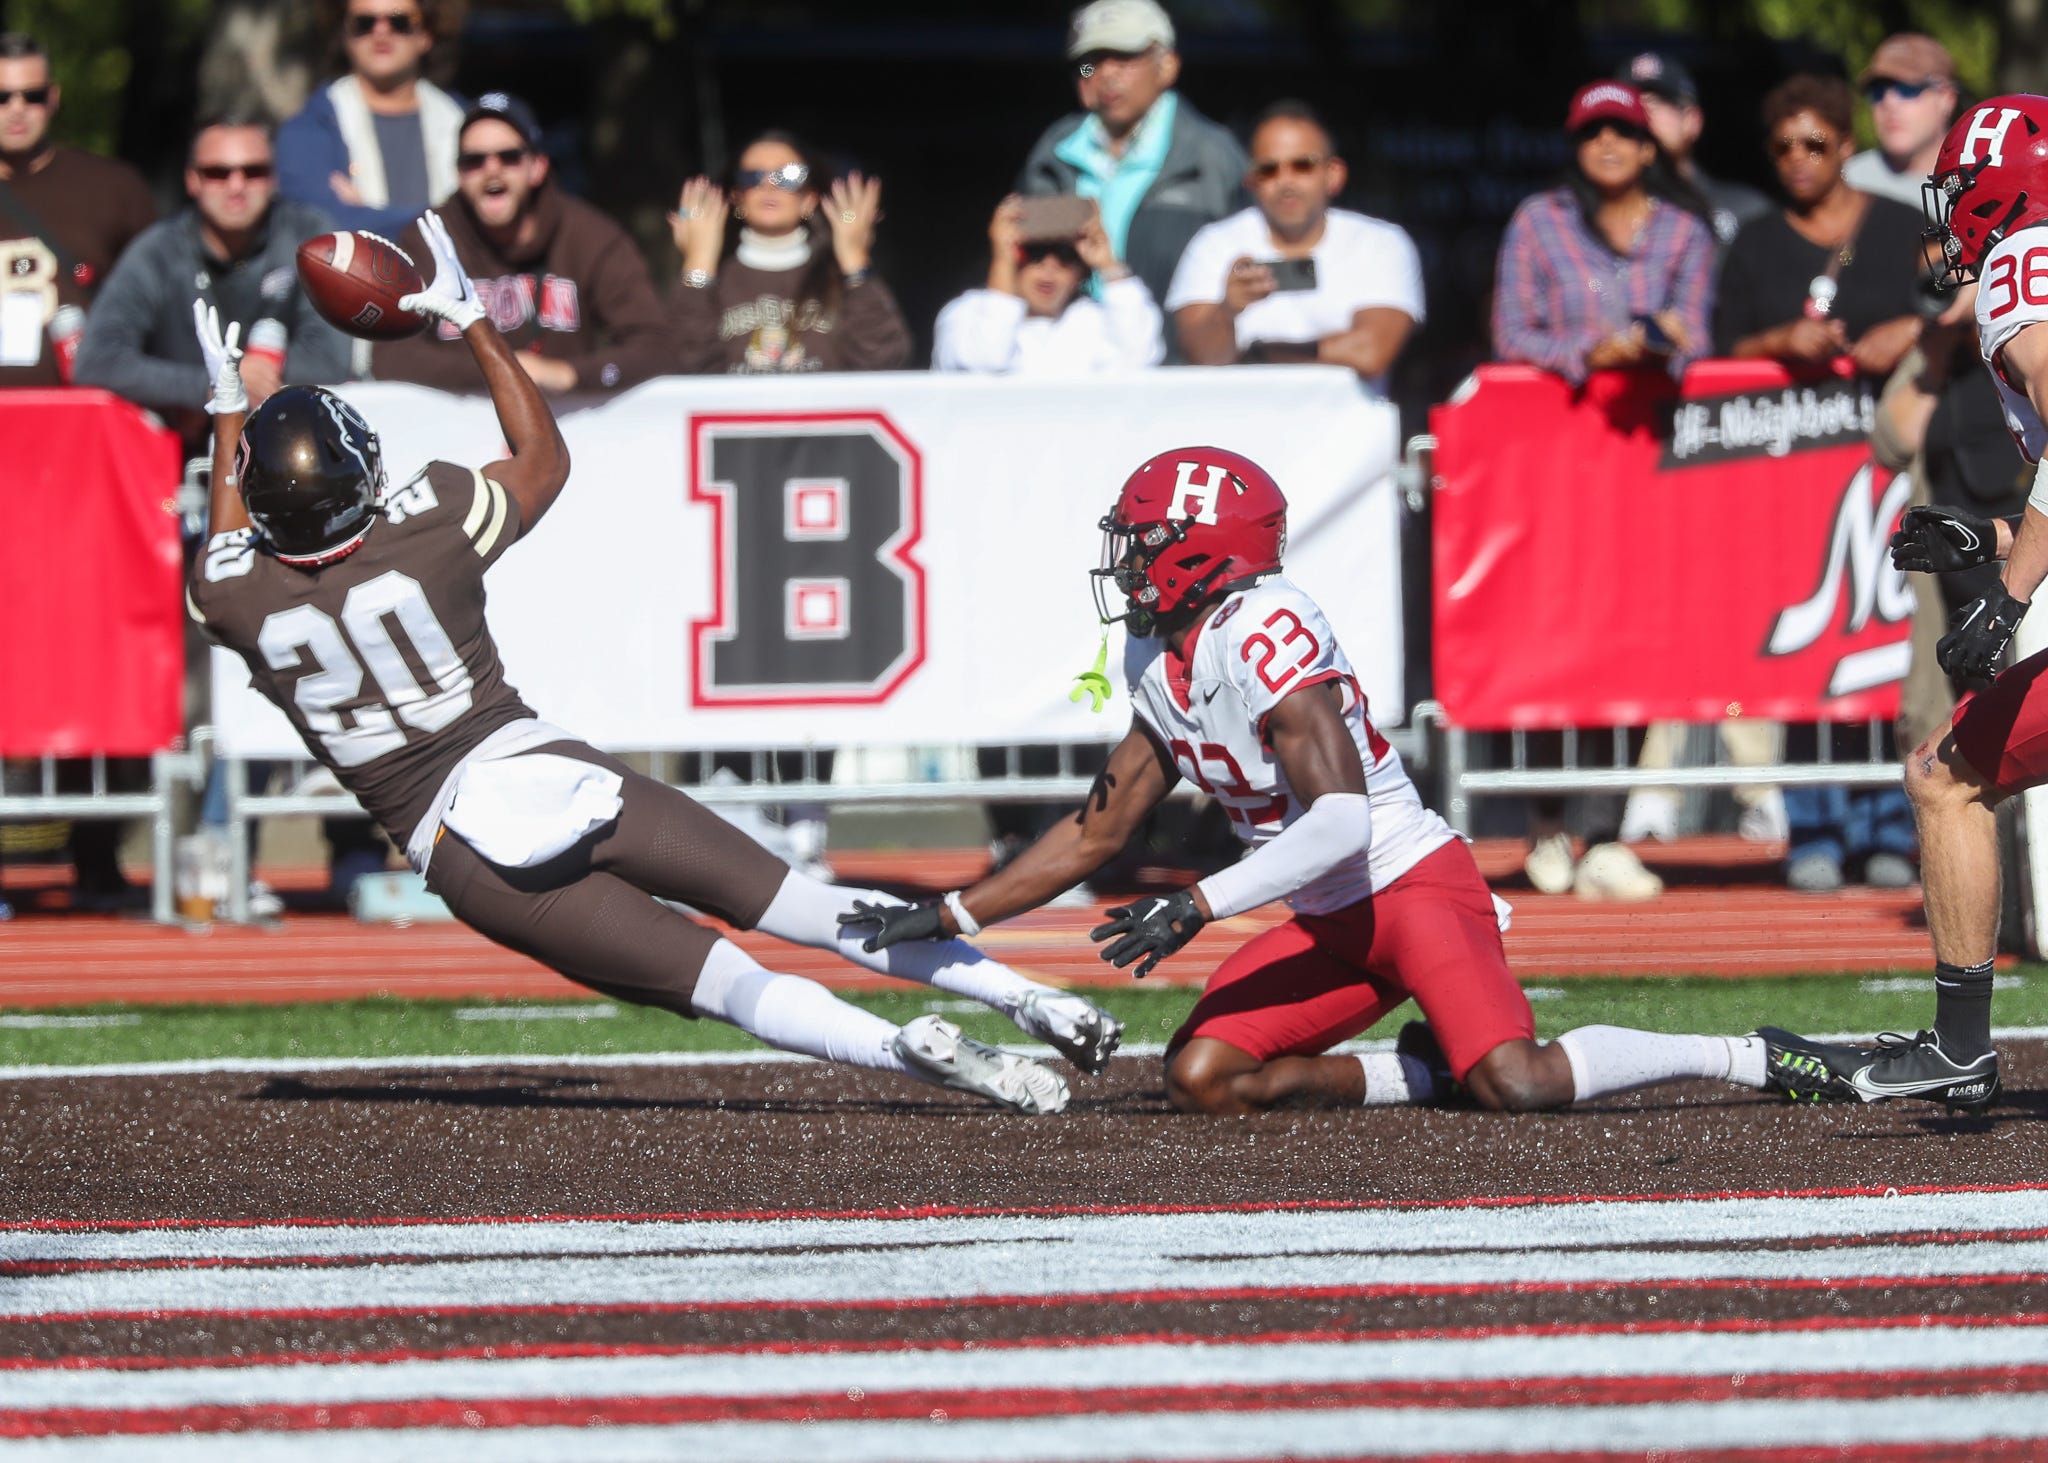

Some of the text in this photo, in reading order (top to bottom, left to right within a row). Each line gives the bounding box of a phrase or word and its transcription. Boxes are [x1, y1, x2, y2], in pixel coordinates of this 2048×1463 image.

[1959, 107, 2022, 168] H
[352, 301, 384, 328] B
[1989, 246, 2048, 321] 36
[1166, 462, 1227, 526] H
[205, 526, 255, 583] 20
[690, 412, 926, 708] B
[257, 569, 475, 768] 20
[1241, 608, 1319, 695] 23
[1170, 739, 1289, 826] 23
